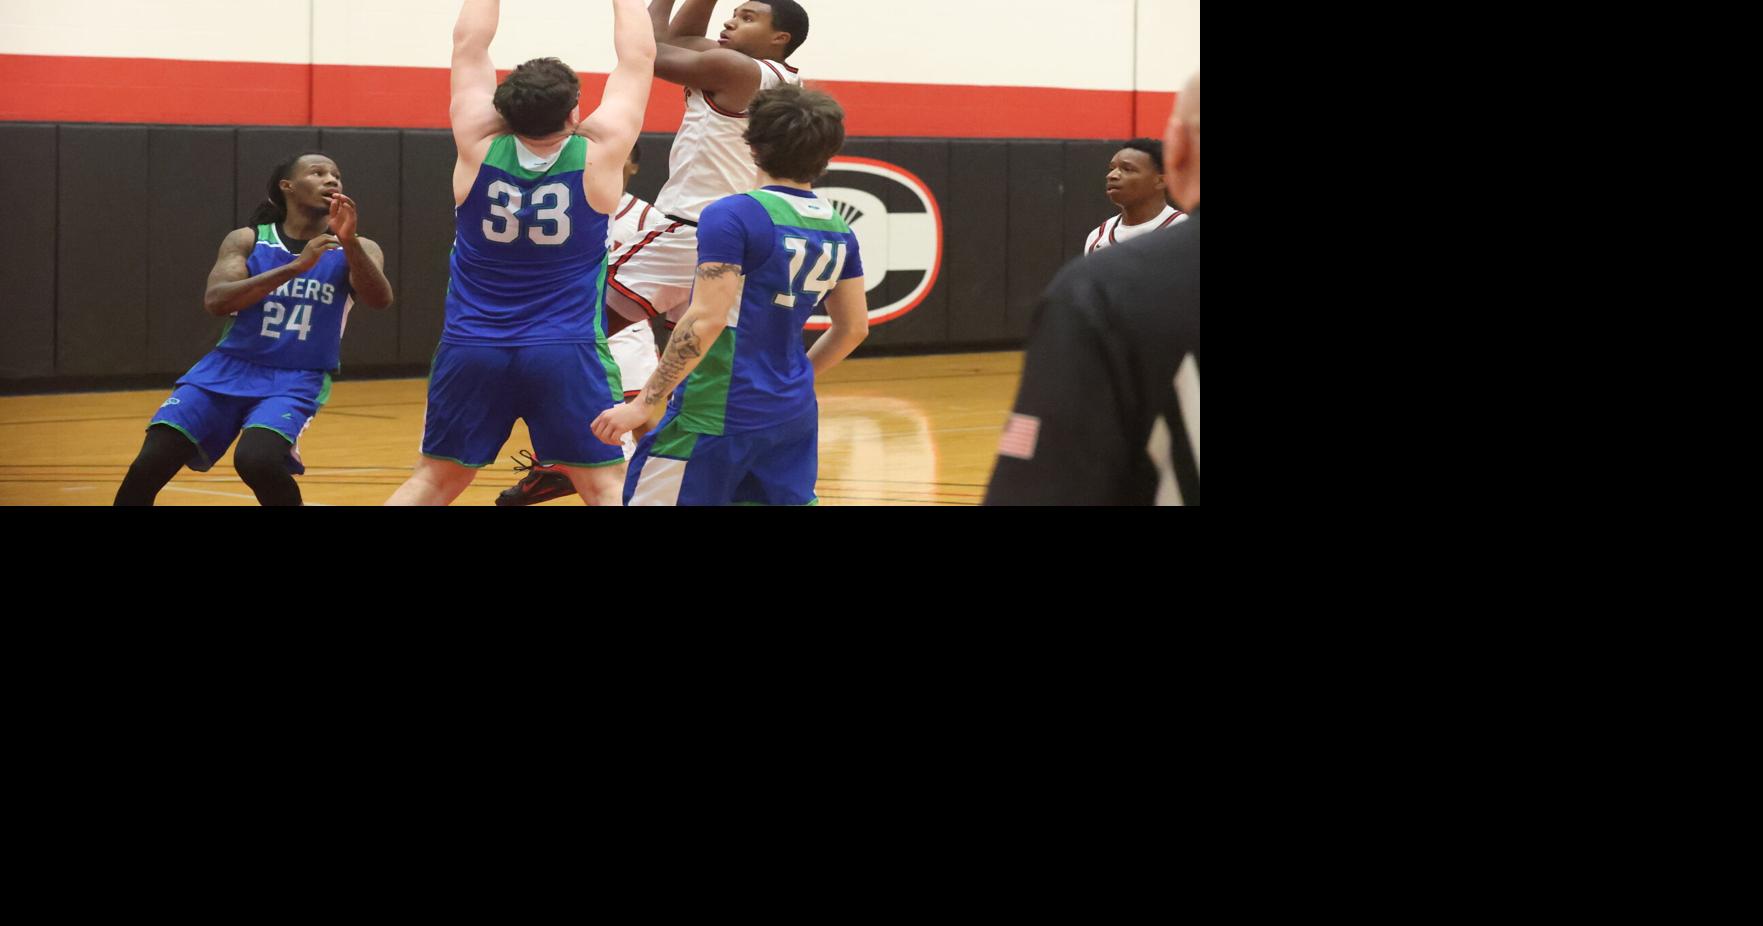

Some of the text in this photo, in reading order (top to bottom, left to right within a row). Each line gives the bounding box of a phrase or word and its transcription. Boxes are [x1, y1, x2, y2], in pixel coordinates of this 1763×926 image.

[482, 180, 571, 244] 33
[268, 278, 334, 304] KERS
[774, 237, 847, 307] 14
[260, 301, 313, 340] 24
